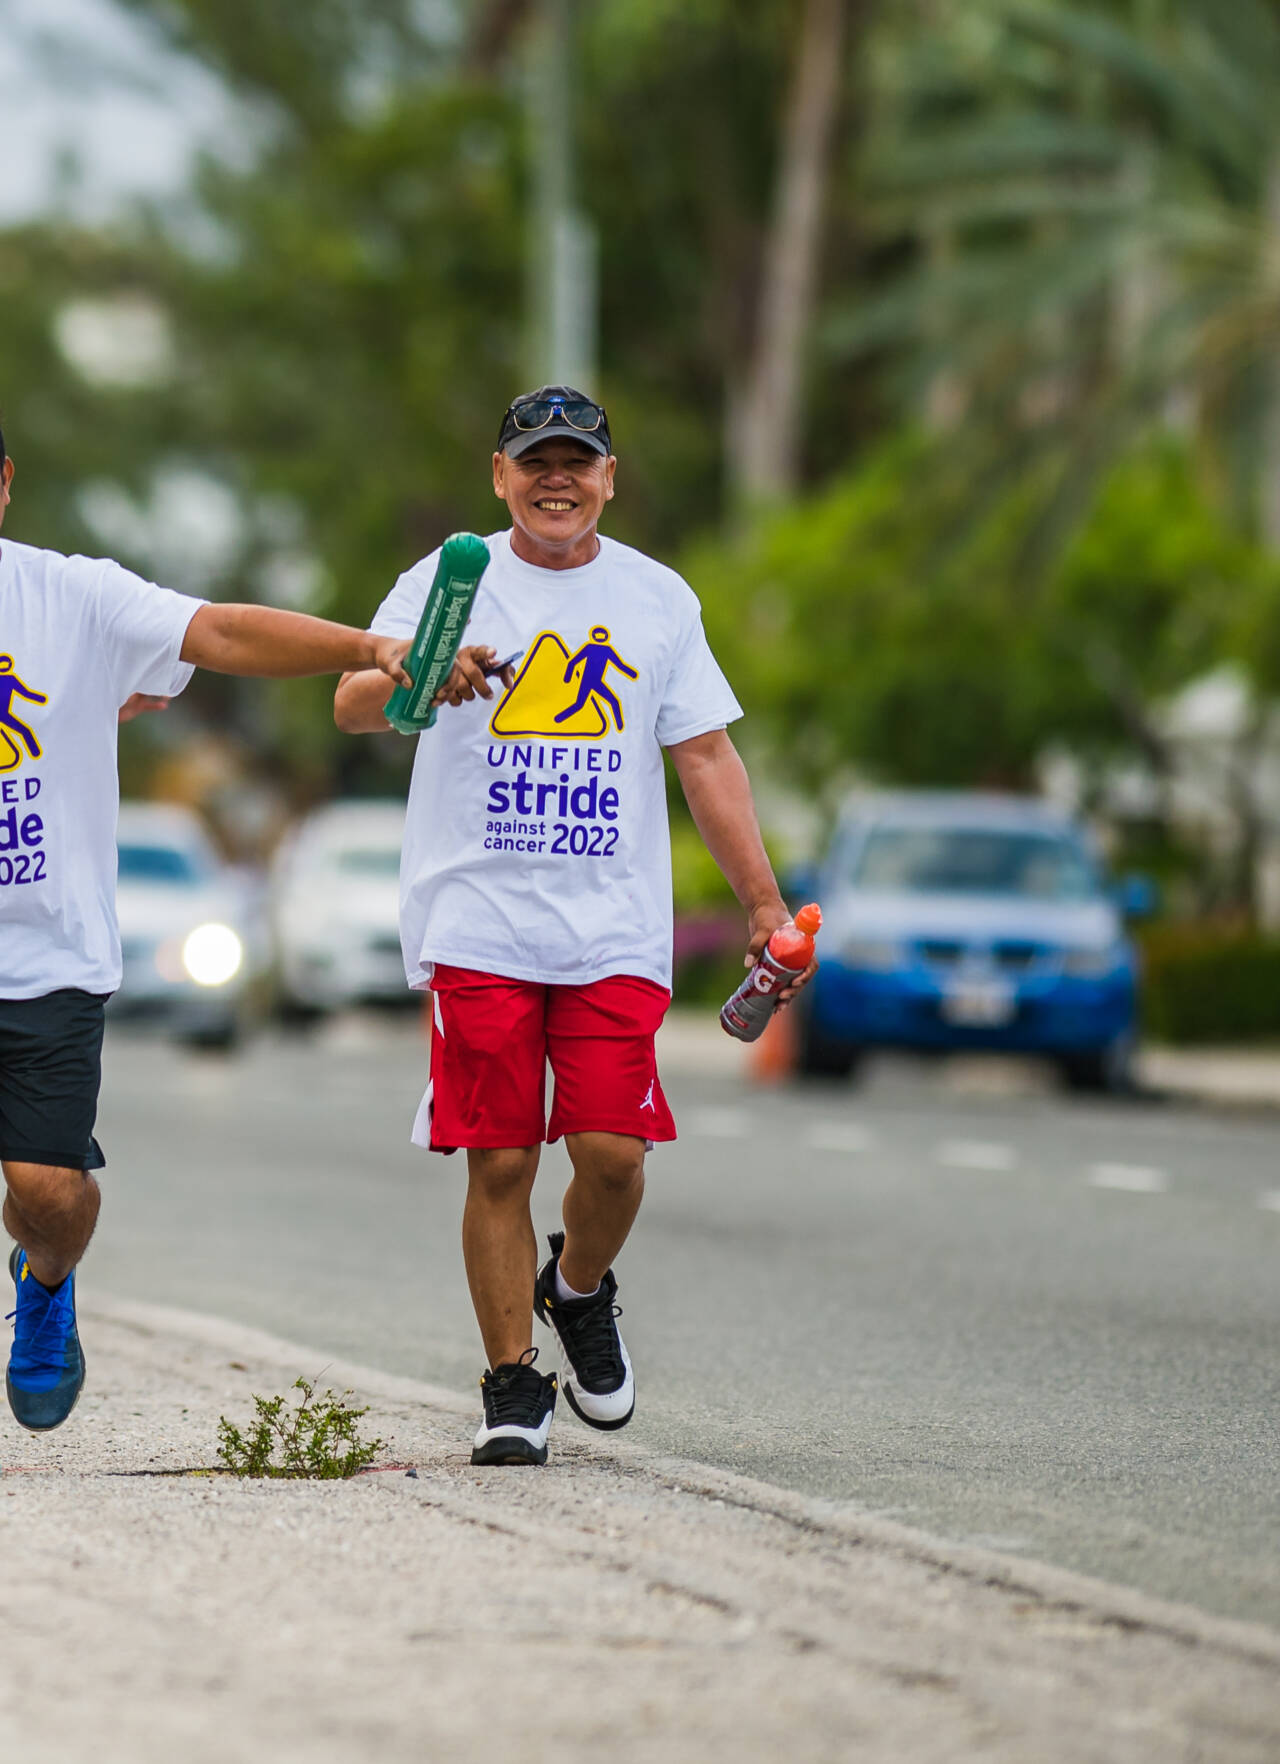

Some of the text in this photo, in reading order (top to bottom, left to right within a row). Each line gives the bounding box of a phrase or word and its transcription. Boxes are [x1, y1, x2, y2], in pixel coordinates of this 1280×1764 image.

[444, 596, 469, 629] Baptist
[434, 629, 458, 660] Health
[413, 662, 447, 718] International
[487, 745, 622, 773] UNIFIED
[486, 771, 619, 821] stride
[486, 819, 546, 835] against
[550, 823, 620, 857] 2022
[484, 837, 546, 853] cancer
[754, 967, 777, 994] G
